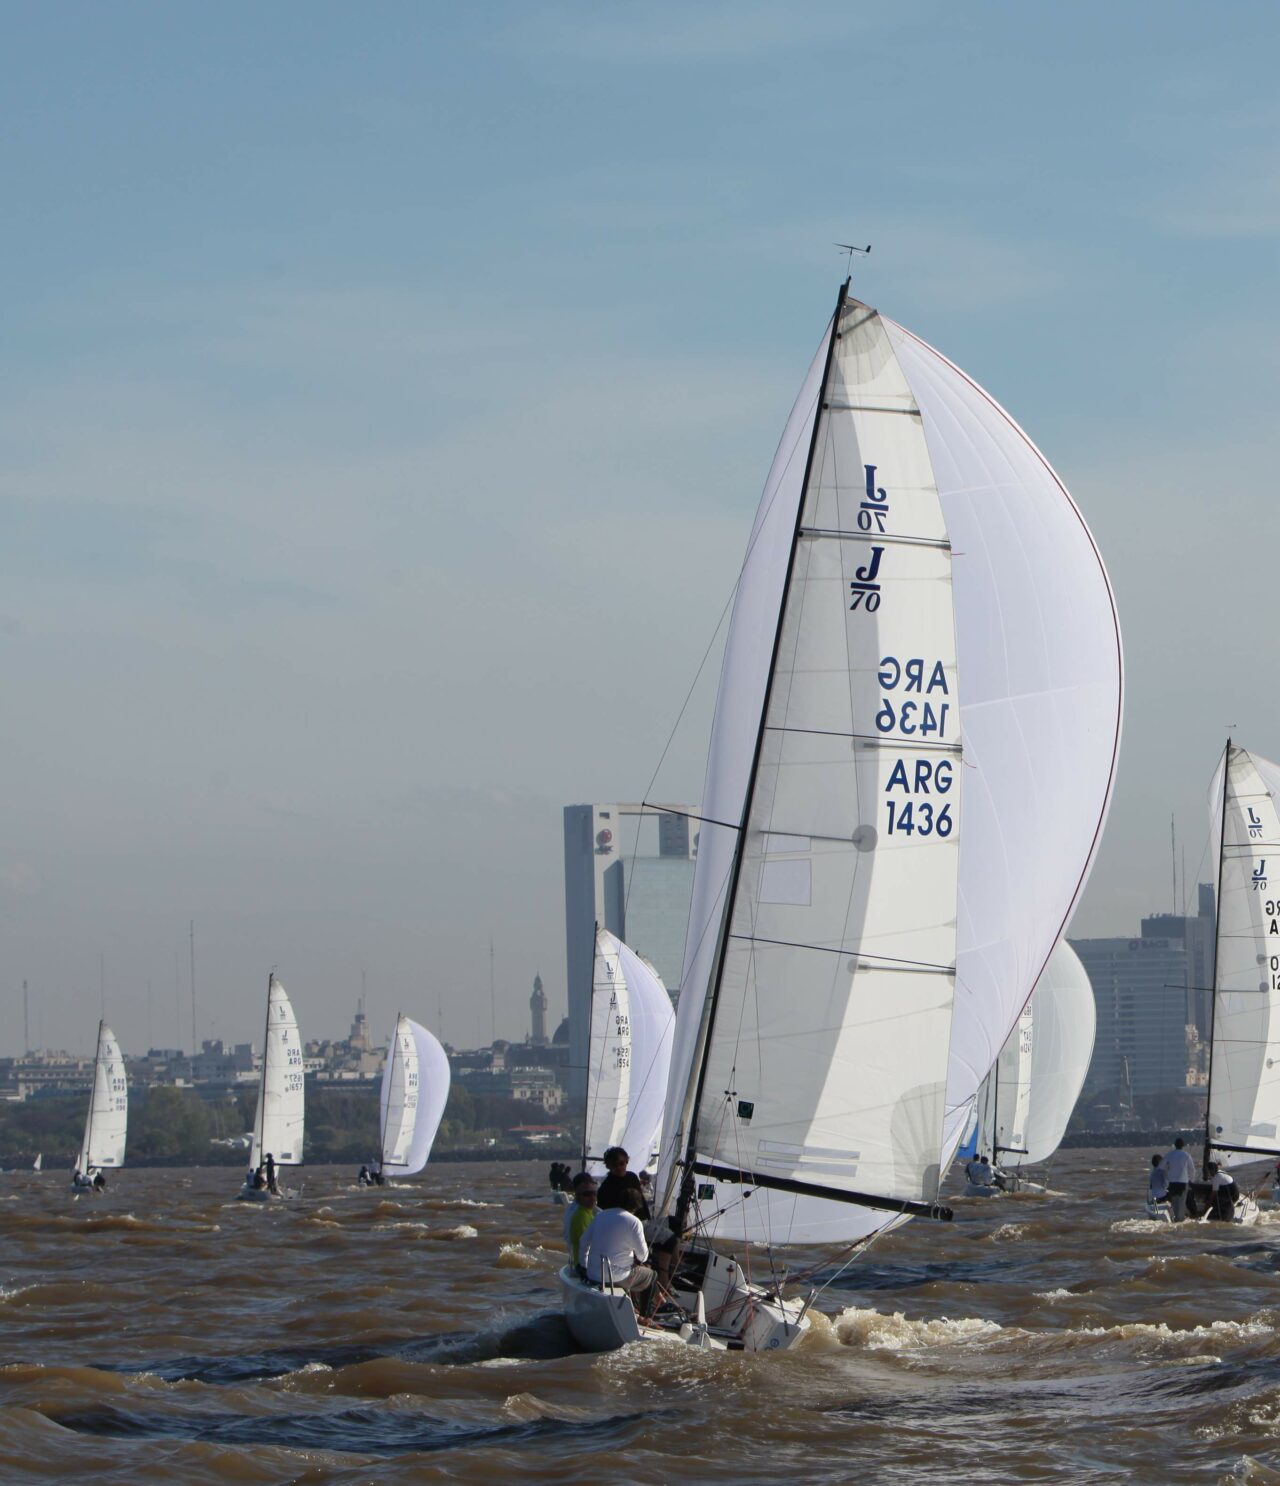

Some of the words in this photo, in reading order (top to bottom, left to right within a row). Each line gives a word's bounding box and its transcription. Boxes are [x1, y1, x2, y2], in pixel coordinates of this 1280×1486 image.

[855, 546, 886, 583] J
[849, 590, 882, 613] 70
[885, 759, 953, 794] ARG
[886, 801, 953, 838] 1436
[1253, 882, 1267, 891] 70
